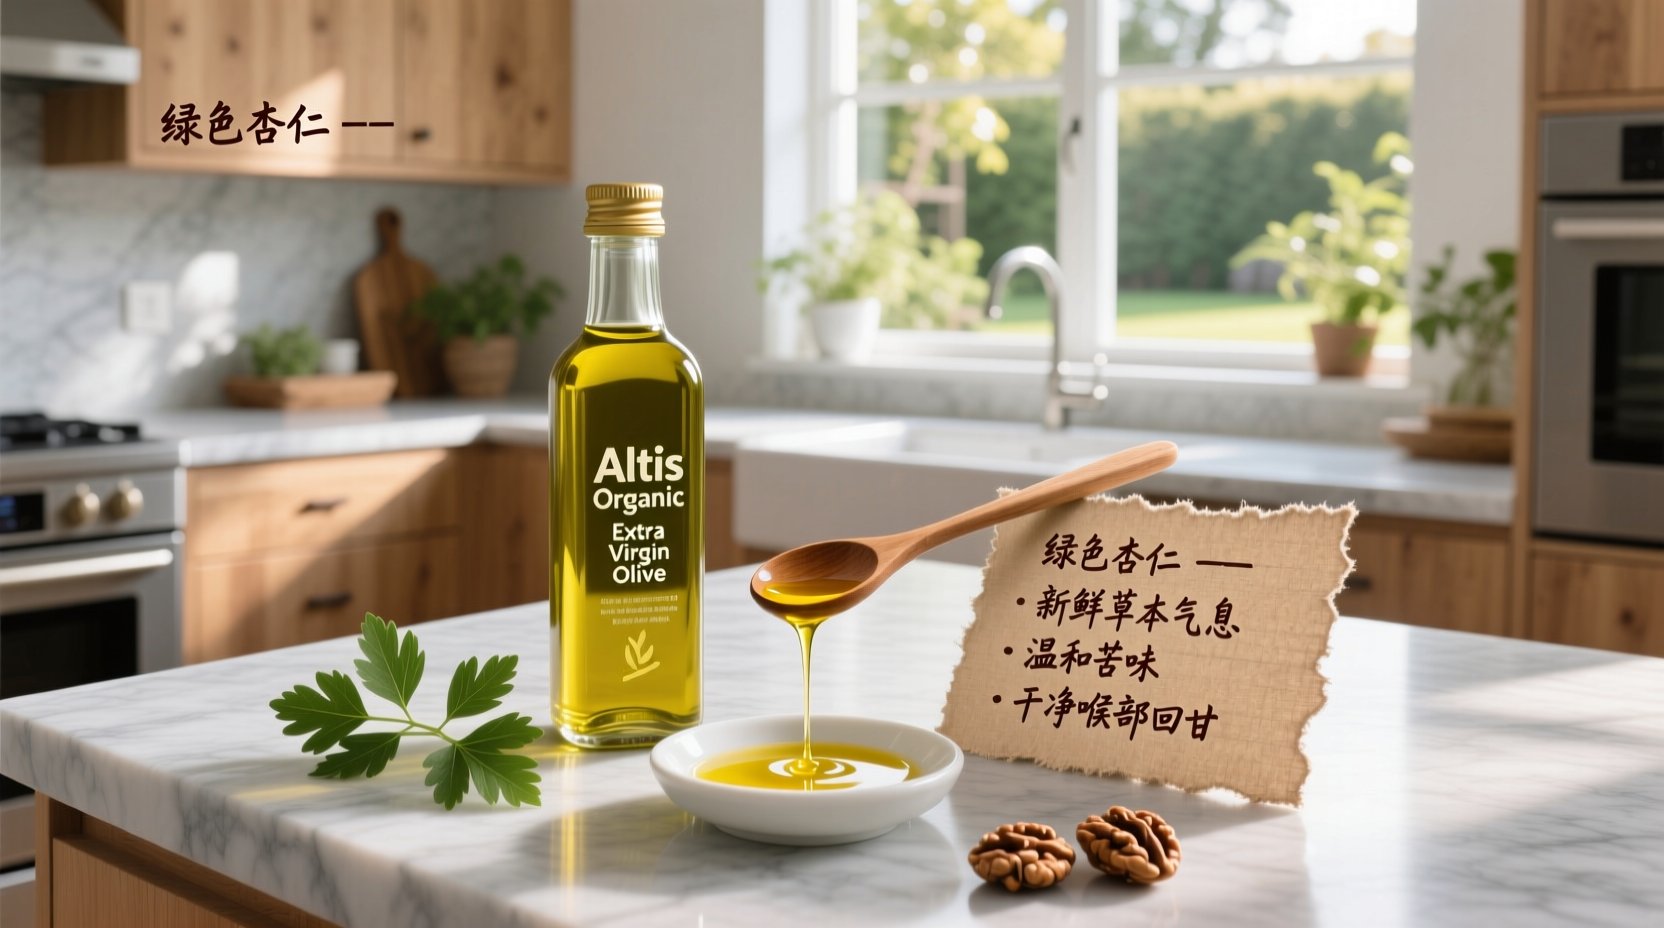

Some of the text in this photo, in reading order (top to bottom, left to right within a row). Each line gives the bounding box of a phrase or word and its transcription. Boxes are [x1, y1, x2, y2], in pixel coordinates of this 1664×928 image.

[593, 444, 684, 484] Altis
[592, 485, 685, 516] Organic
[612, 522, 665, 542] Extra
[608, 543, 670, 566] Virgin
[612, 564, 667, 584] Olive
[1036, 584, 1240, 640] 新鲜草本气息
[1023, 637, 1159, 683] 温和苦味
[1013, 686, 1219, 742] 干净喉部回甘
